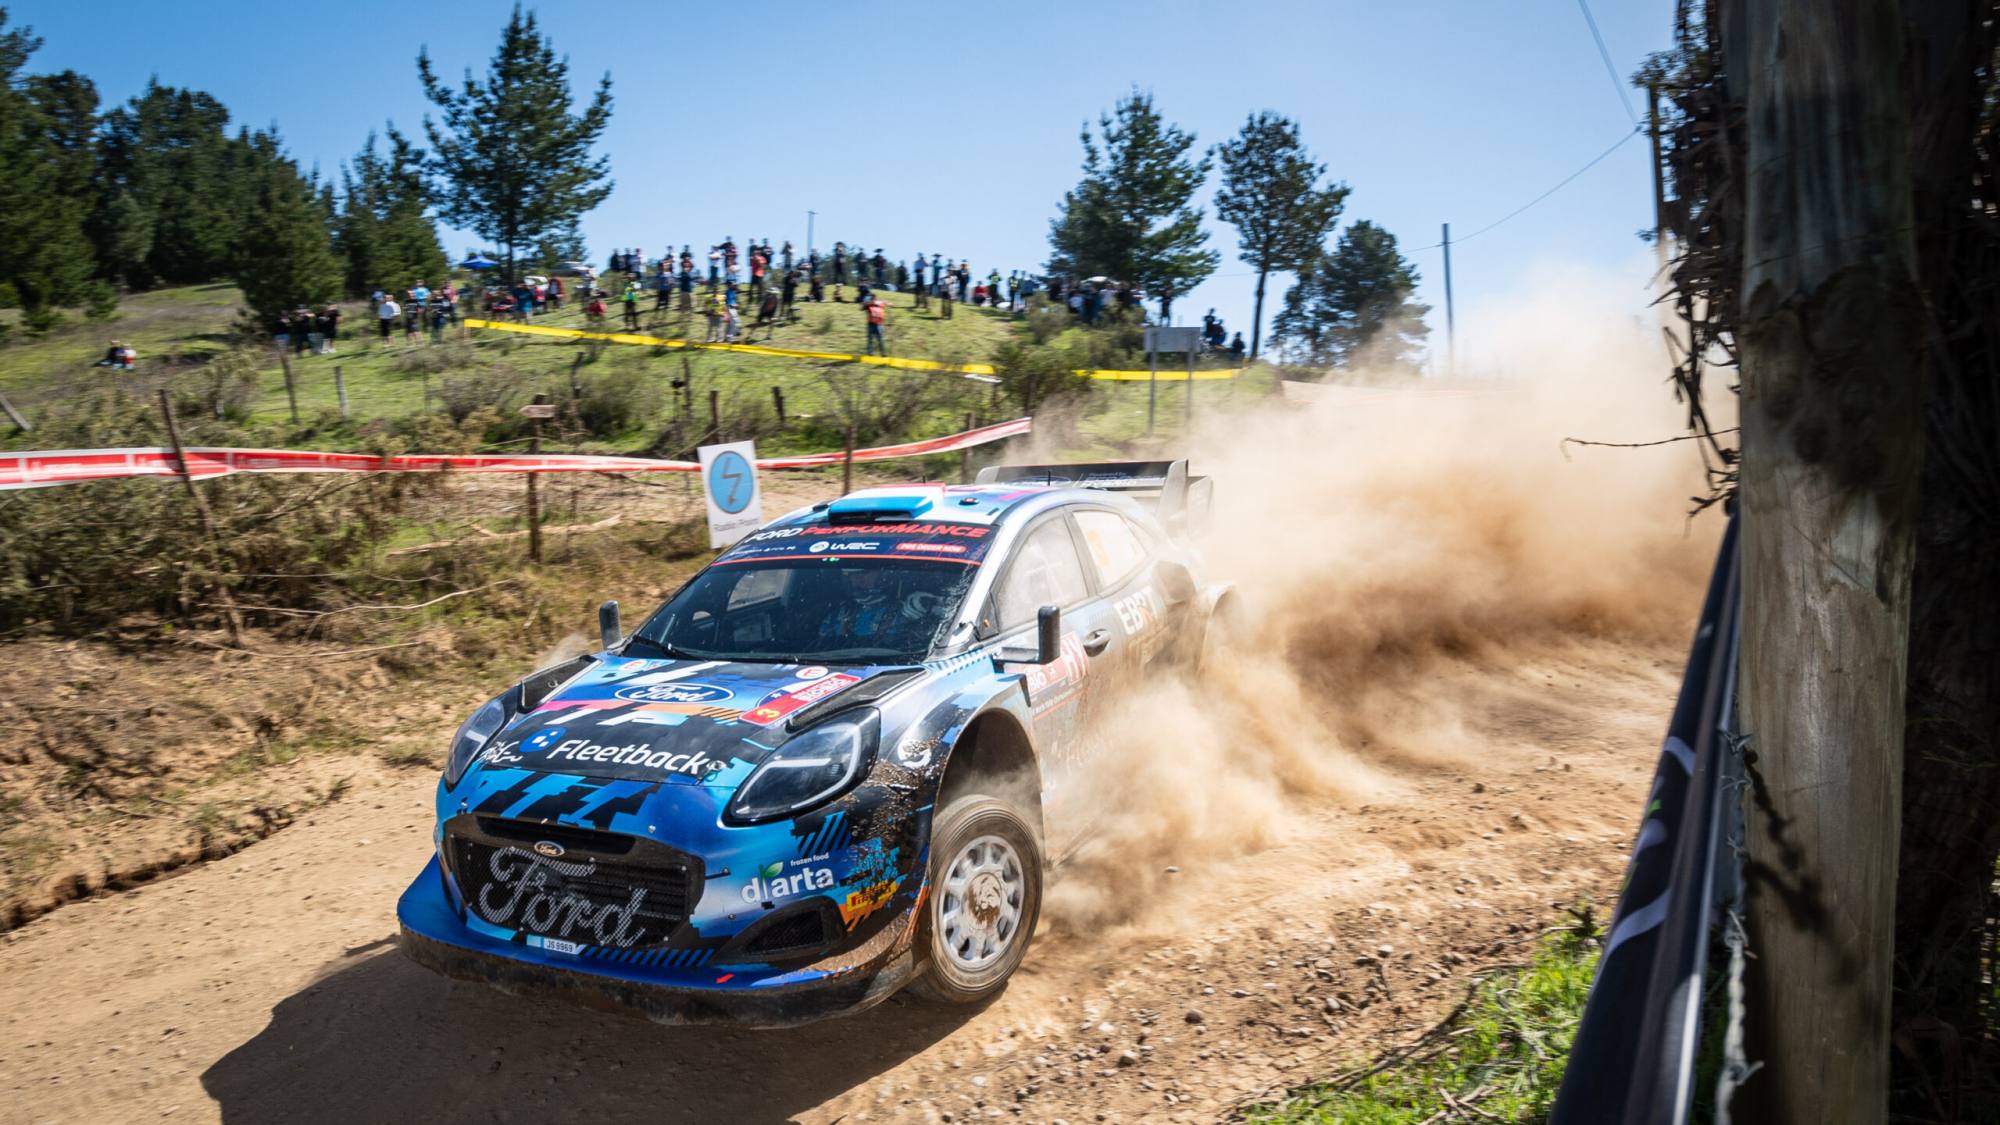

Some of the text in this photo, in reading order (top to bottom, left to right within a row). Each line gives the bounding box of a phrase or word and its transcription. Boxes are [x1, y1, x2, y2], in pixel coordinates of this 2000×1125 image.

[744, 524, 989, 543] FORD PERFORMANCE
[830, 542, 880, 550] WRC
[629, 685, 715, 701] Ford
[757, 709, 780, 718] 3
[546, 739, 708, 774] Fleetback
[790, 852, 830, 867] frozen food
[479, 847, 648, 947] Ford
